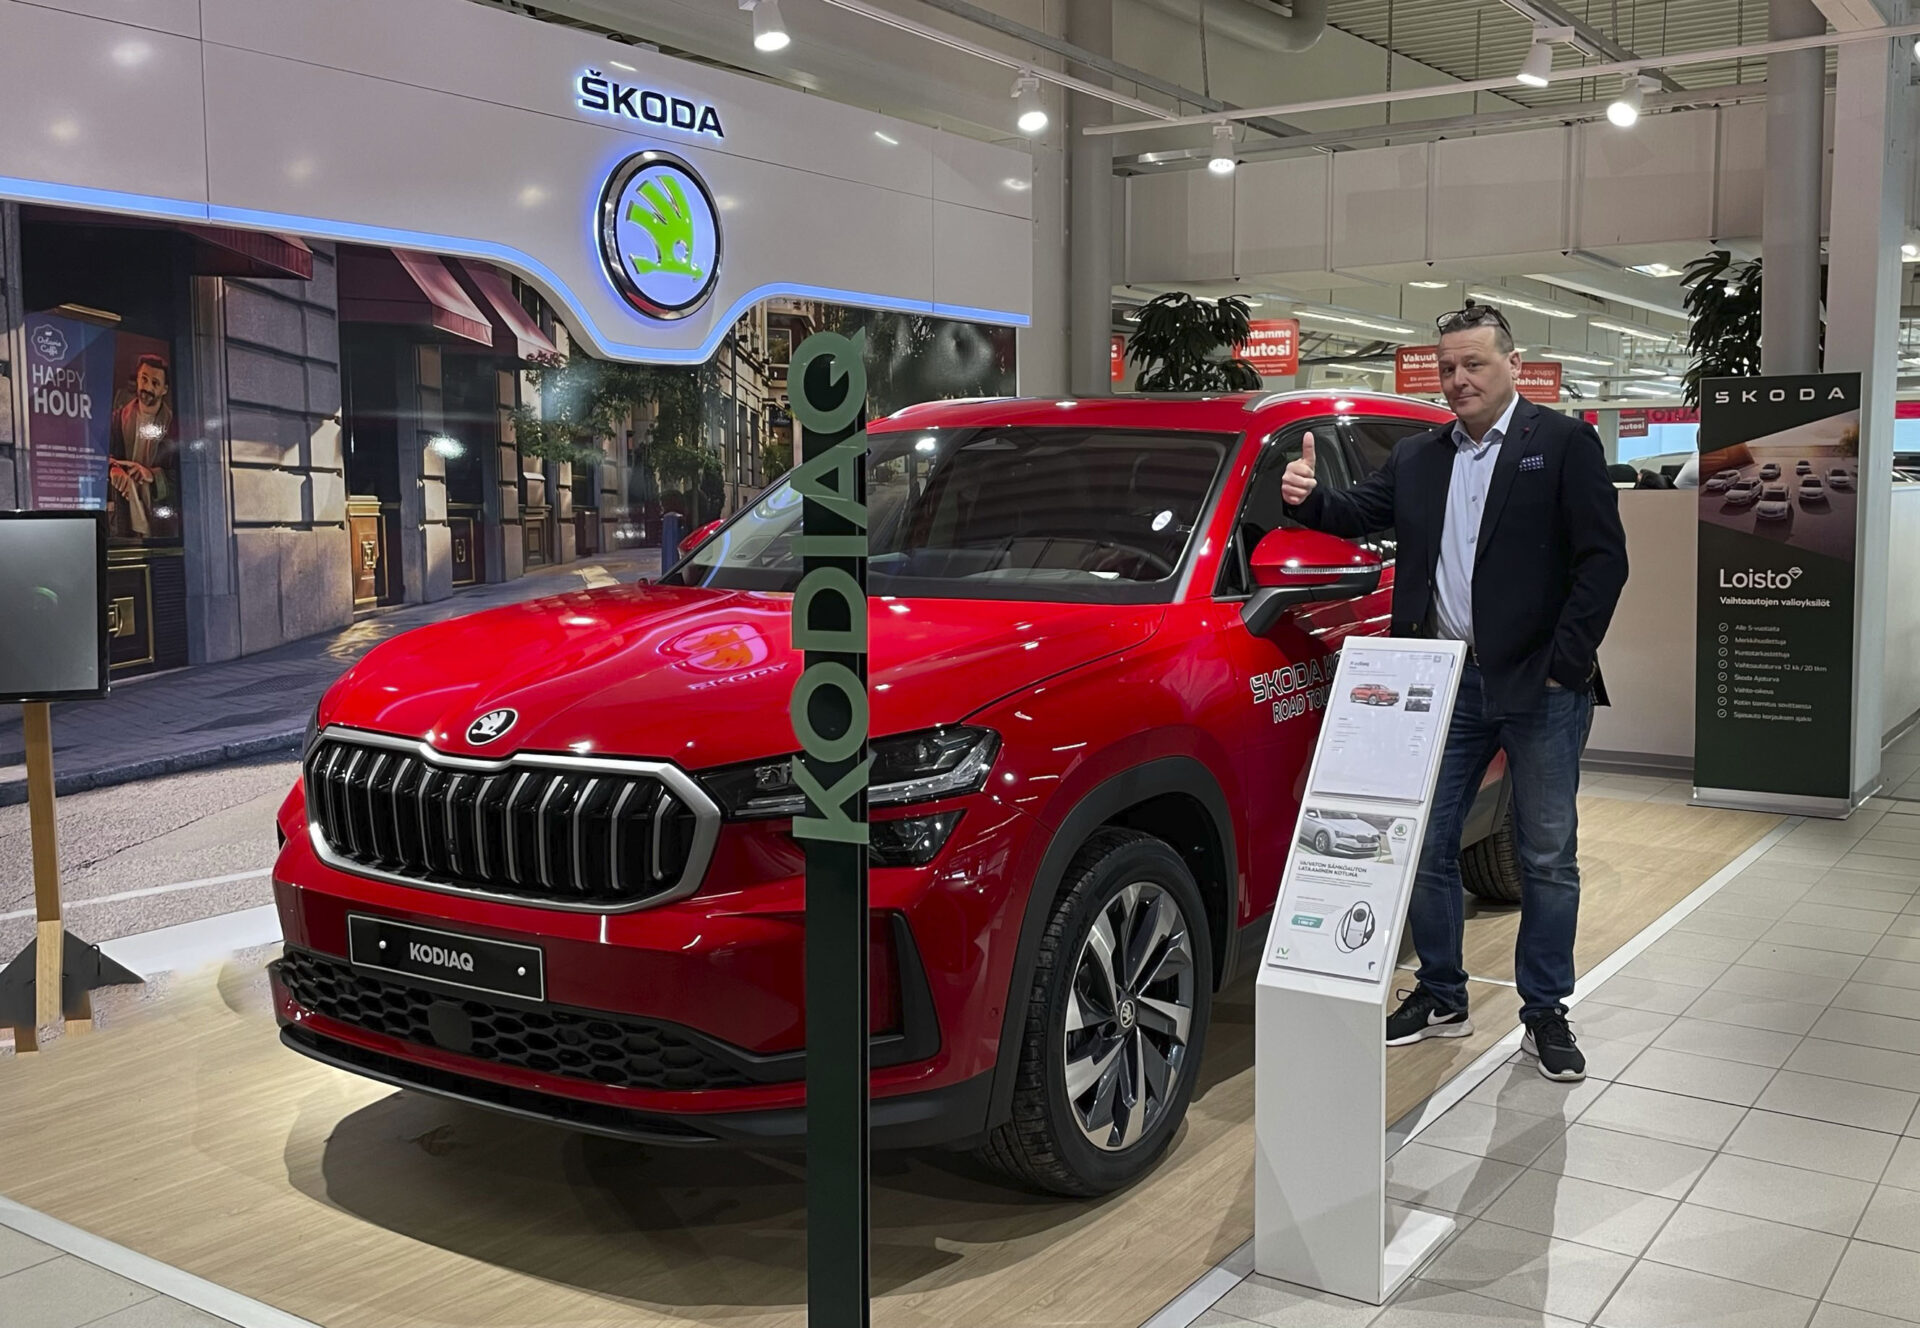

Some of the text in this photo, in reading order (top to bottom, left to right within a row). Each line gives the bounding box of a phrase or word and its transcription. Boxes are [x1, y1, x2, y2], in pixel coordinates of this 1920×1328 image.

[579, 69, 725, 138] ŠKODA
[1240, 340, 1290, 357] autosi
[1402, 353, 1437, 362] Vakuut
[32, 363, 86, 390] HAPPY
[33, 387, 92, 419] HOUR
[787, 327, 869, 843] KODIAQ
[1720, 568, 1792, 589] Loisto
[1720, 596, 1831, 608] Vaihtoautojen valioyksilöt
[1272, 693, 1306, 724] ROAD
[409, 942, 474, 972] KODIAQ
